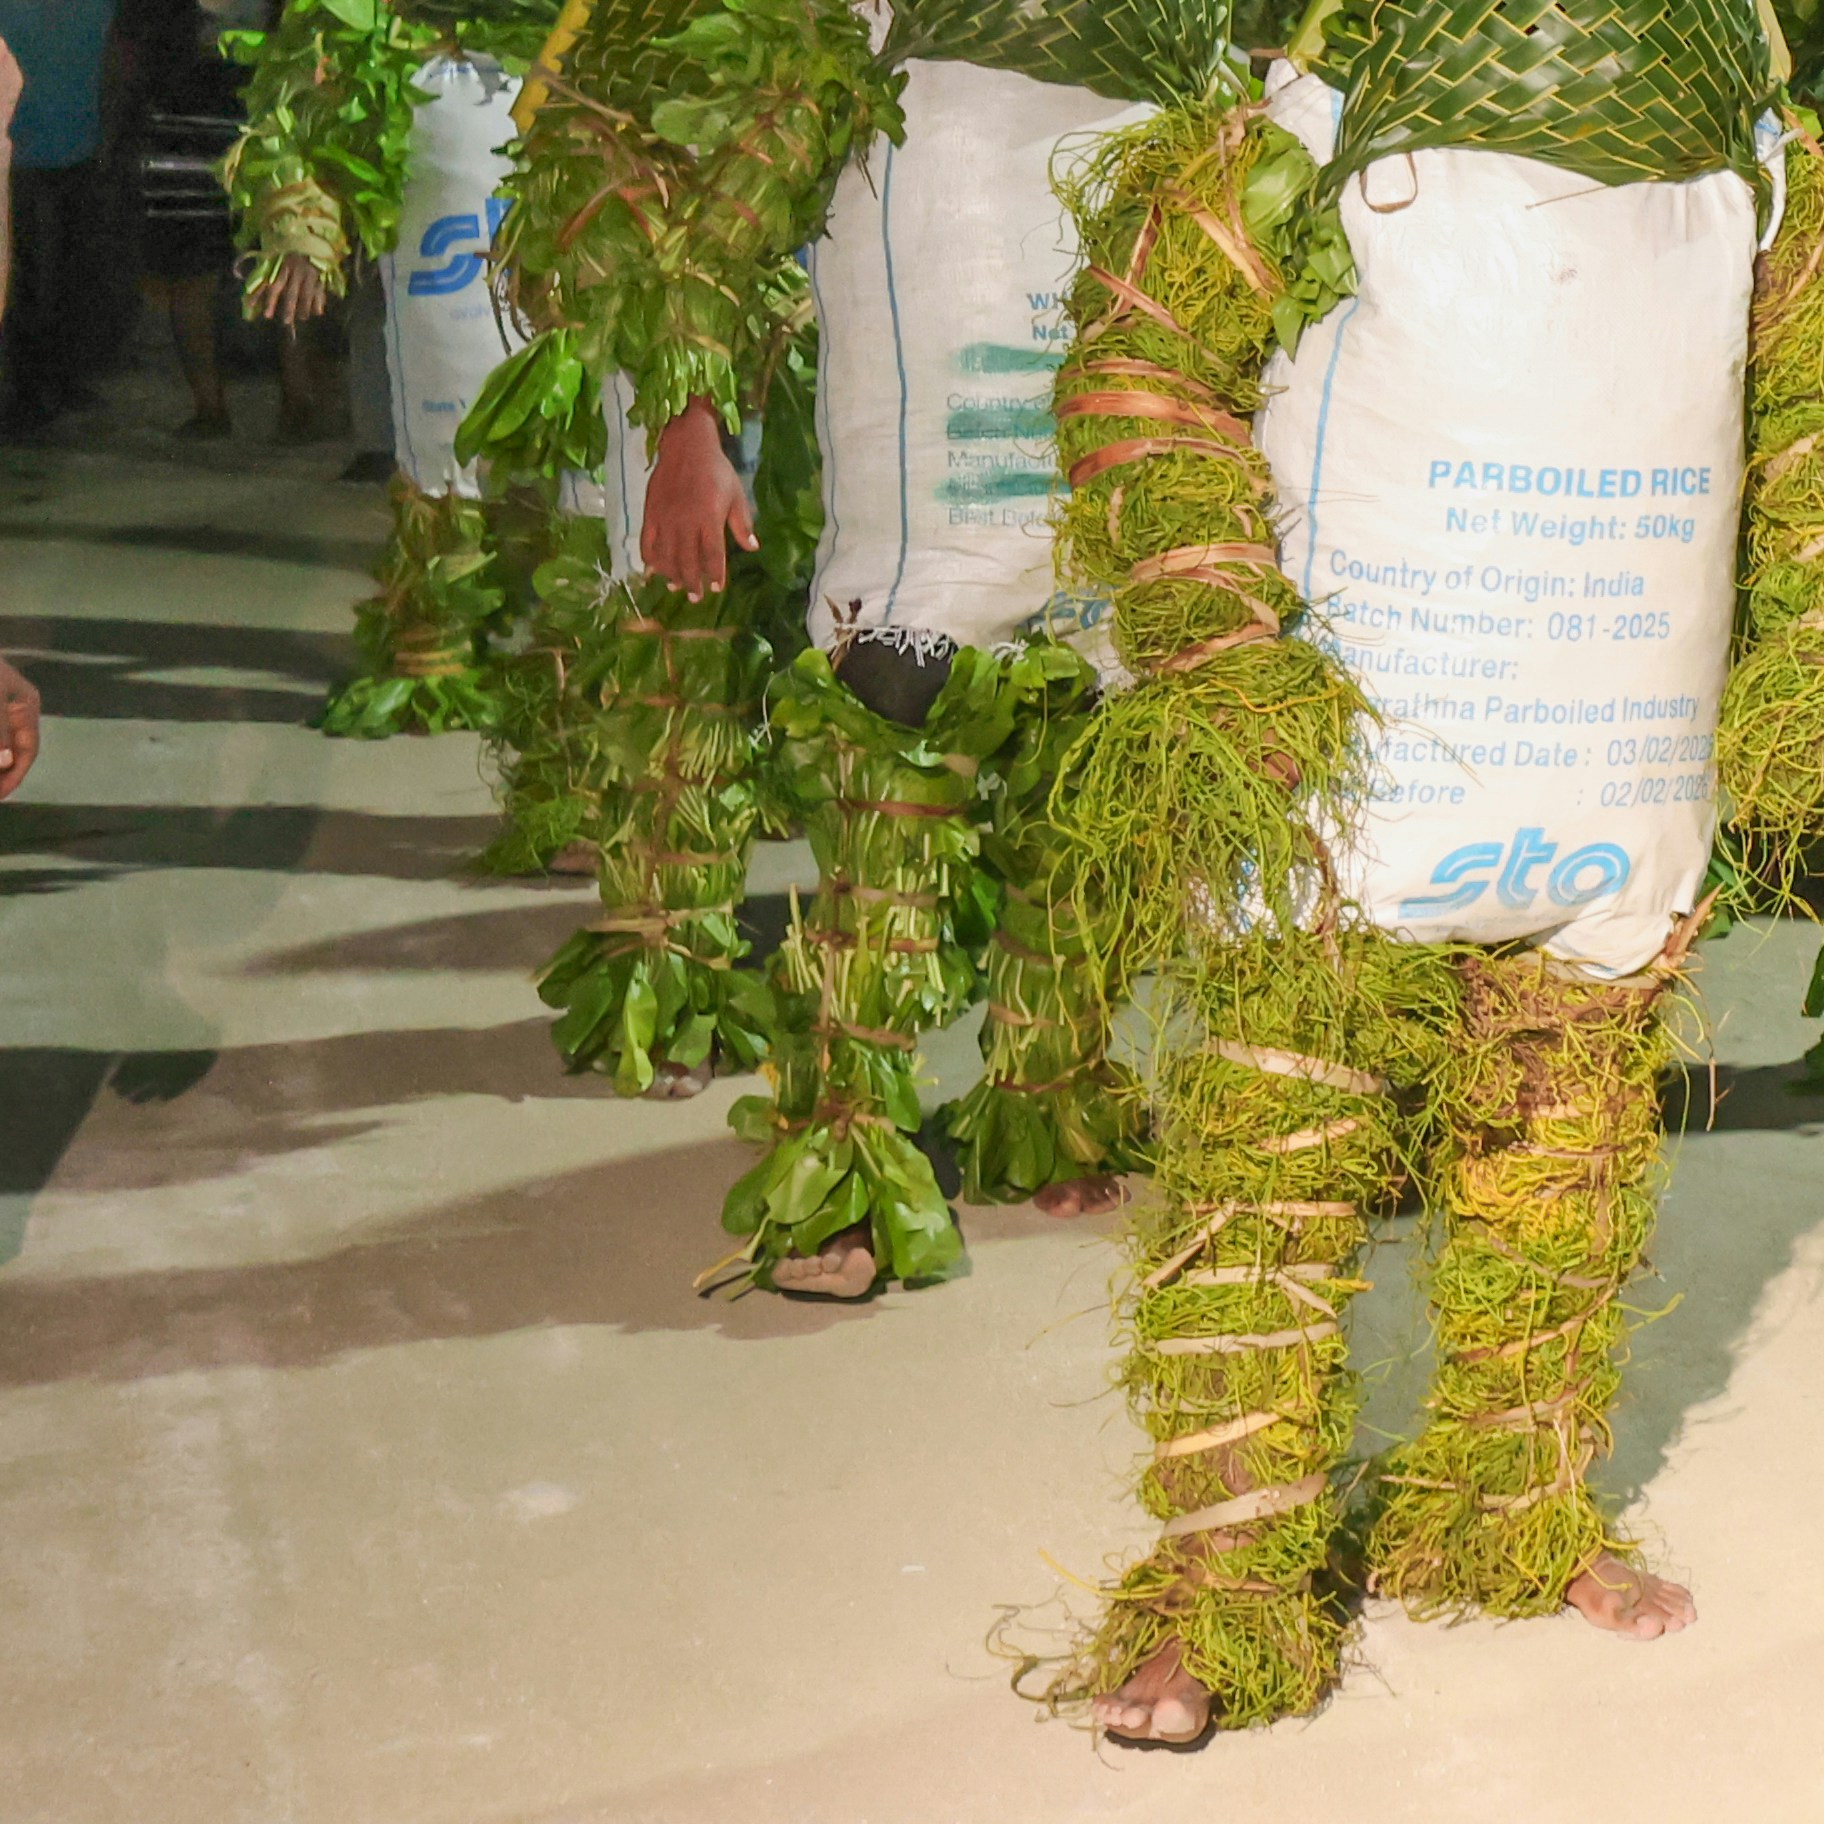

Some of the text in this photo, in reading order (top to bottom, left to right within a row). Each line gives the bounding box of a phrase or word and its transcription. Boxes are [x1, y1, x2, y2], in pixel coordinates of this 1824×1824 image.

[1428, 459, 1712, 499] PARBOILED RICE
[1445, 506, 1696, 547] Net Weight: 50kg
[1329, 549, 1645, 603] Country of Origin: India
[1326, 592, 1671, 643] Batch Number: 081-2025
[1484, 696, 1615, 725] Parboiled
[1622, 693, 1699, 725] Industry
[1514, 740, 1578, 768] Date
[1400, 826, 1631, 919] sto
